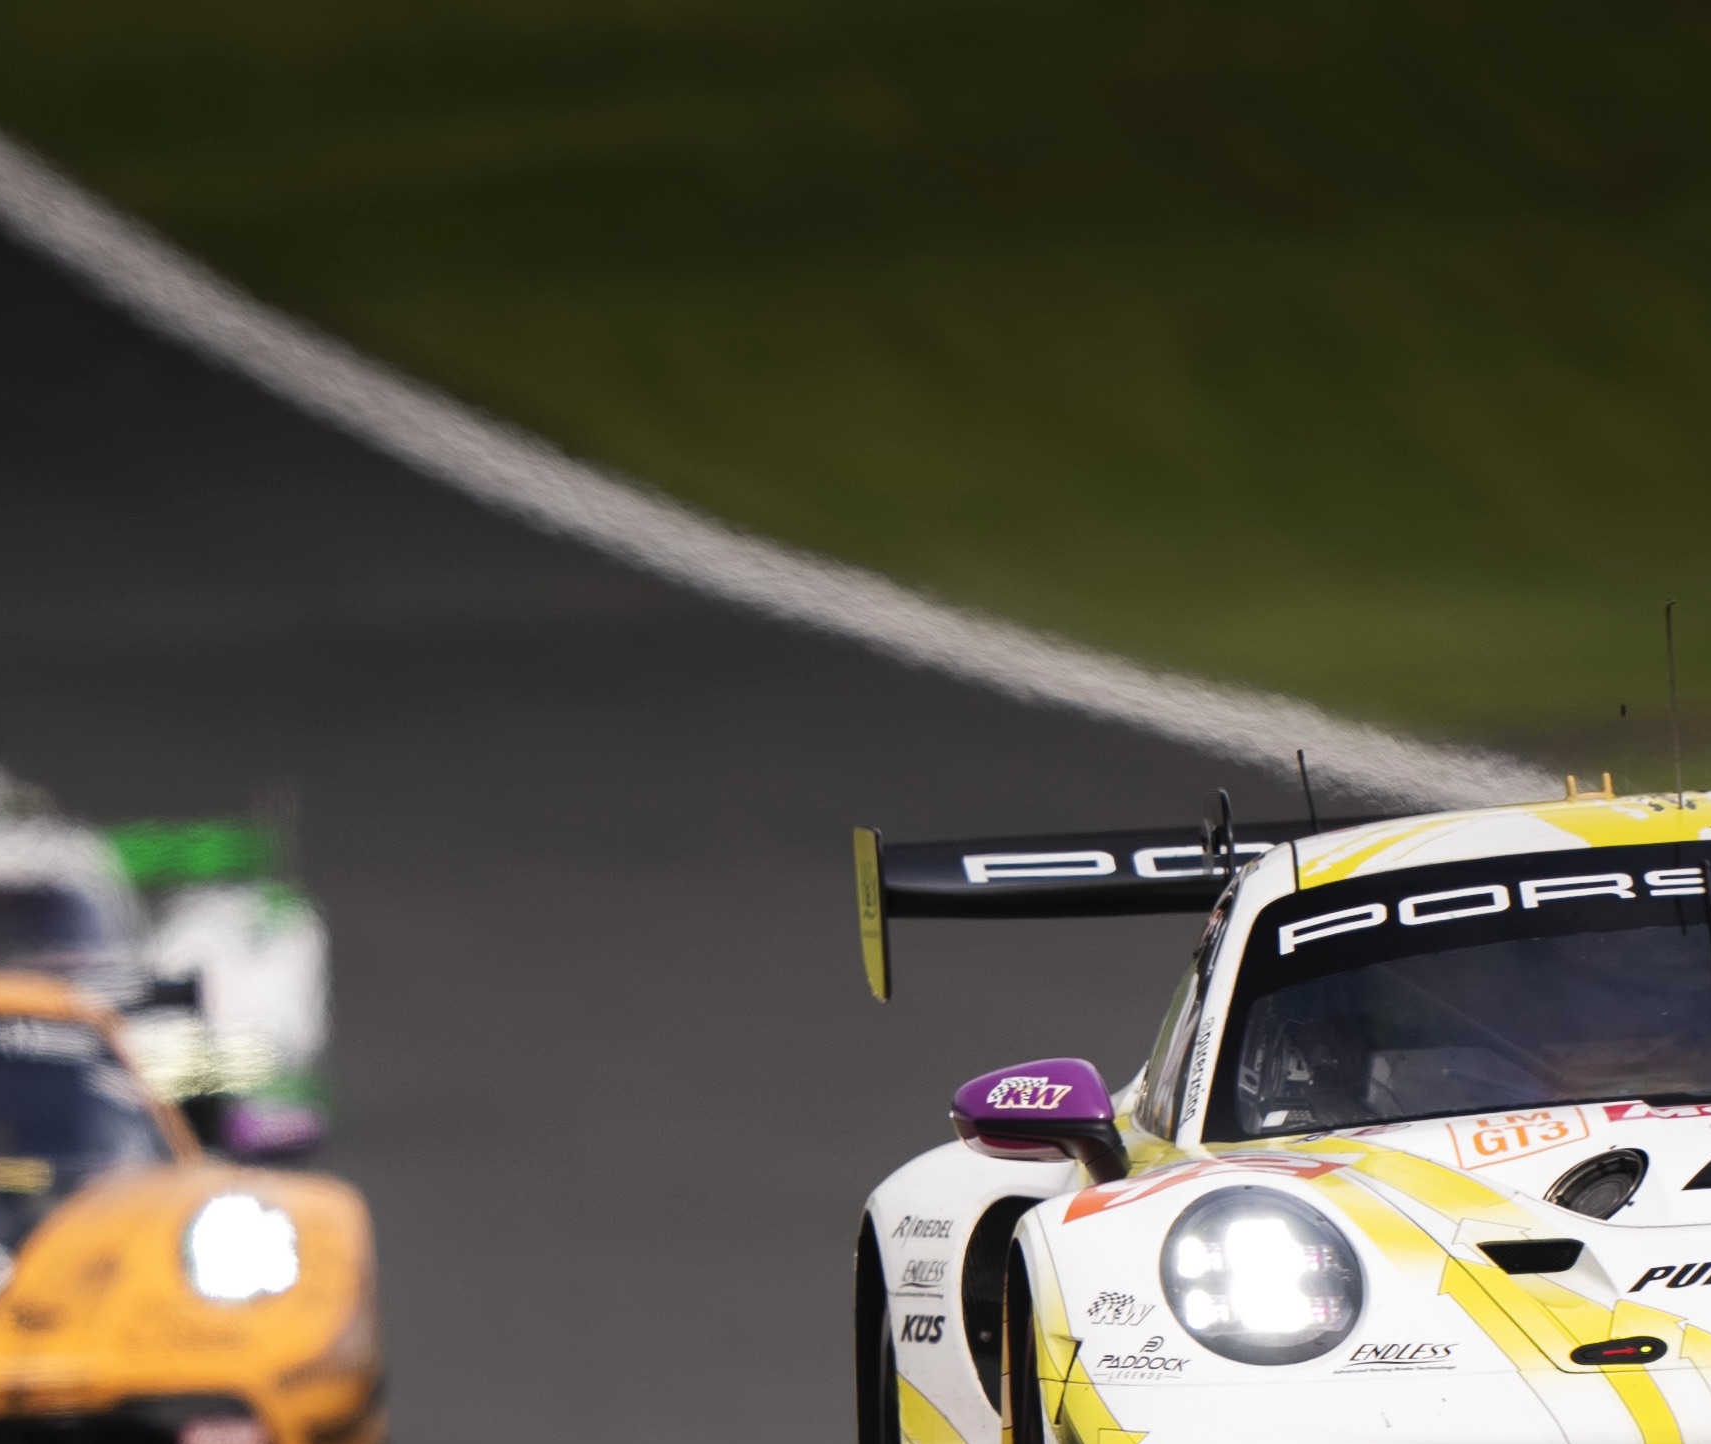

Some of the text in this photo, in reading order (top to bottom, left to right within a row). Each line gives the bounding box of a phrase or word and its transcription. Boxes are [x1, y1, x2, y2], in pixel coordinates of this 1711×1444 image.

[1473, 1120, 1569, 1156] GT3
[1348, 1342, 1460, 1361] ENDLESS
[1097, 1354, 1192, 1371] PADDOCK
